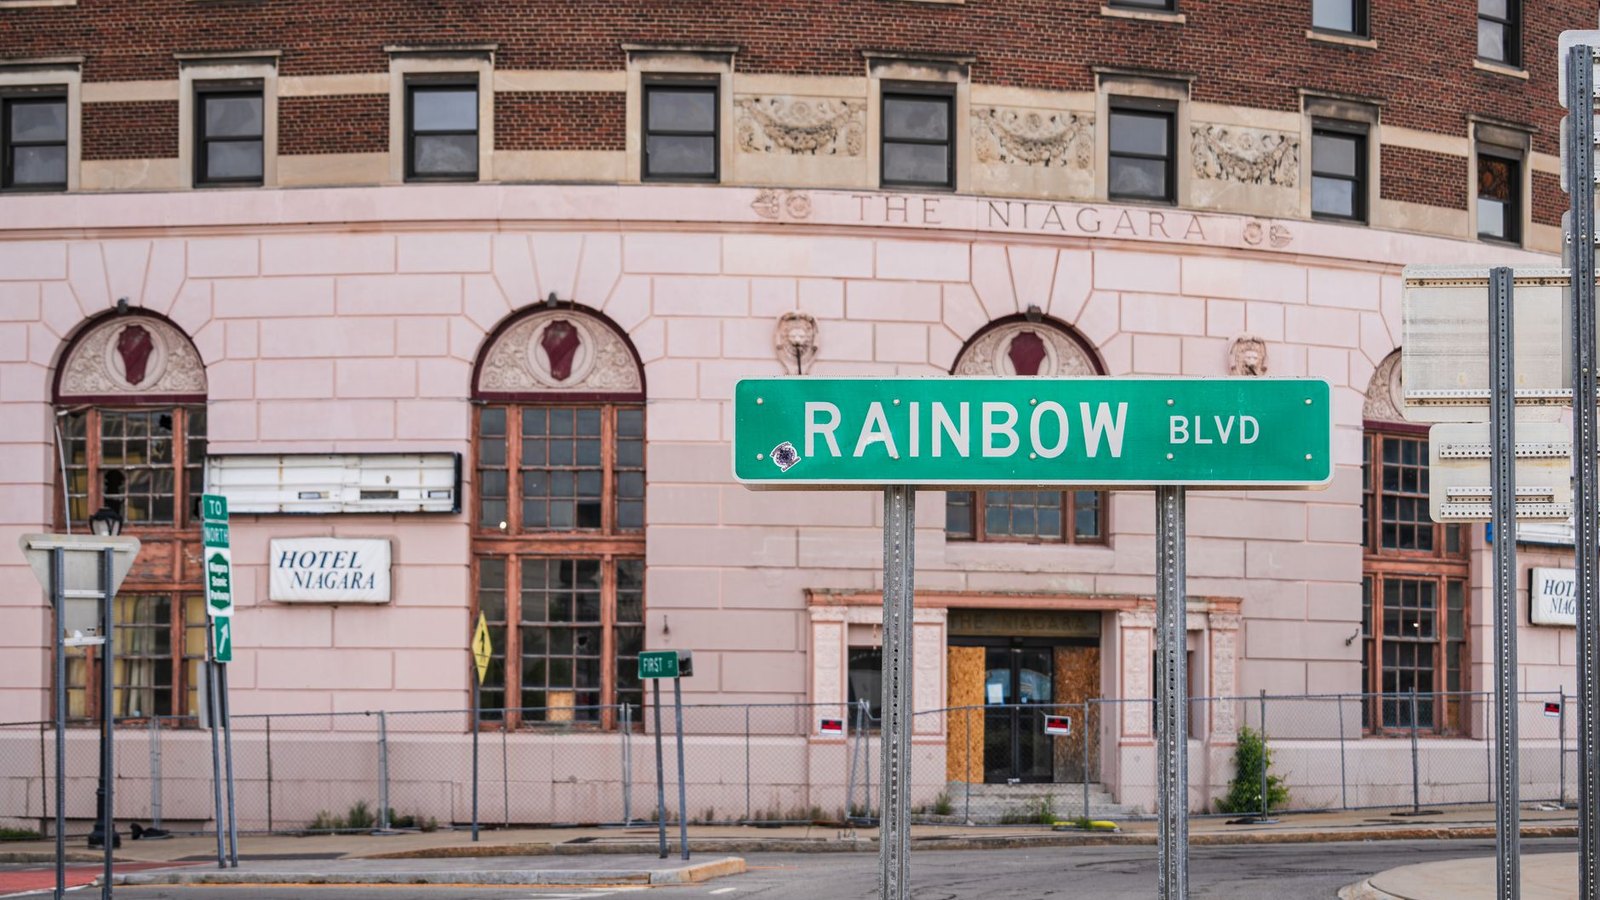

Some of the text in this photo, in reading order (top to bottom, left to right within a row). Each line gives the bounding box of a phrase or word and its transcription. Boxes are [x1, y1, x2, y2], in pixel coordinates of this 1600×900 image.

[851, 194, 1207, 241] THE NIAGARA
[804, 400, 1260, 459] RAINBOW BLVD
[208, 499, 222, 515] TO
[204, 526, 229, 543] NORTH
[278, 550, 363, 569] HOTEL
[289, 571, 376, 590] NIAGARA
[1543, 579, 1576, 597] HOT
[998, 613, 1089, 631] NIAGARA
[643, 657, 663, 672] FIRST
